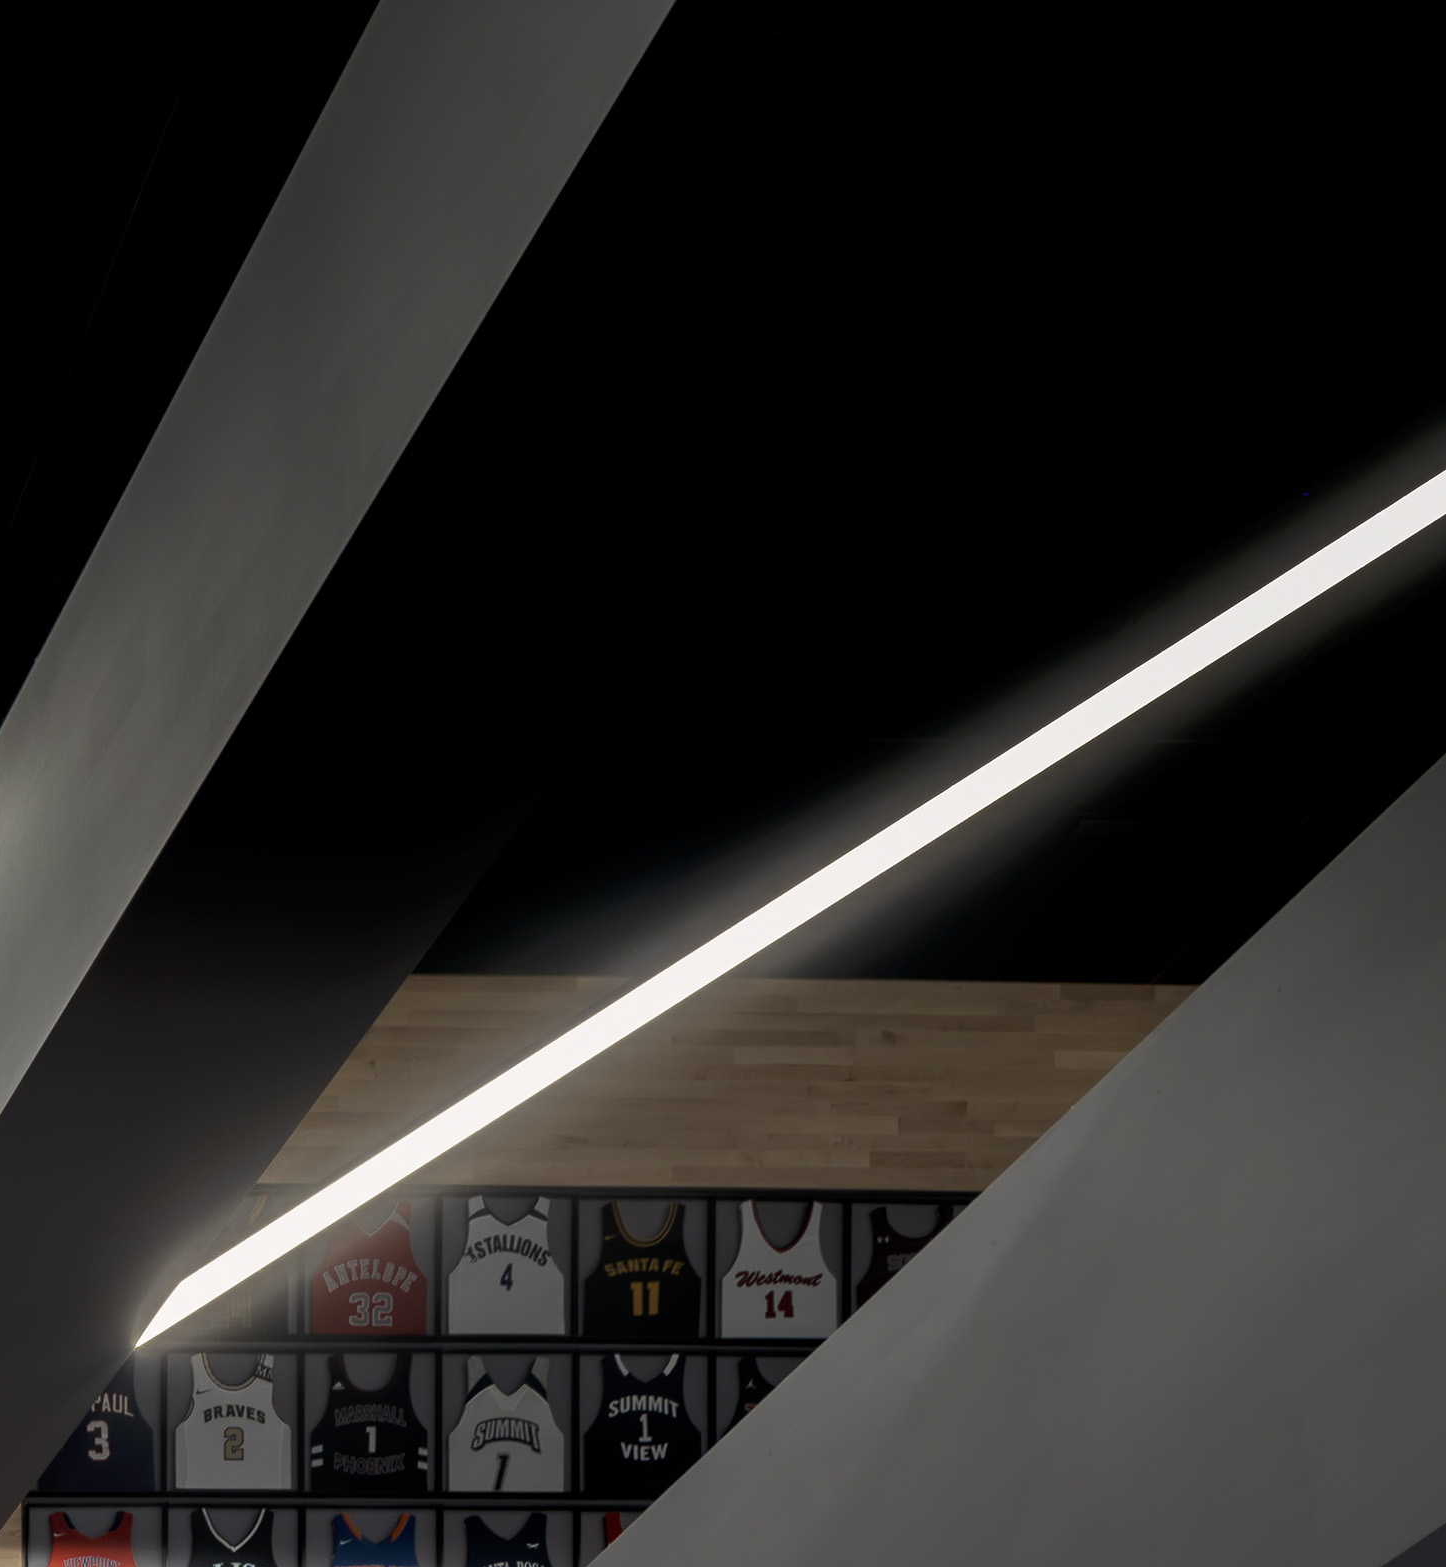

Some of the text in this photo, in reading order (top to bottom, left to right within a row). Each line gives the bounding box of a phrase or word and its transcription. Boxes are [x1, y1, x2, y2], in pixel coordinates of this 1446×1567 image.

[323, 1259, 417, 1292] ANTELOPE
[736, 1270, 823, 1289] Westmont
[203, 1405, 266, 1425] BRAVES
[470, 1418, 541, 1453] SUMMIT
[621, 1443, 668, 1461] VIEW
